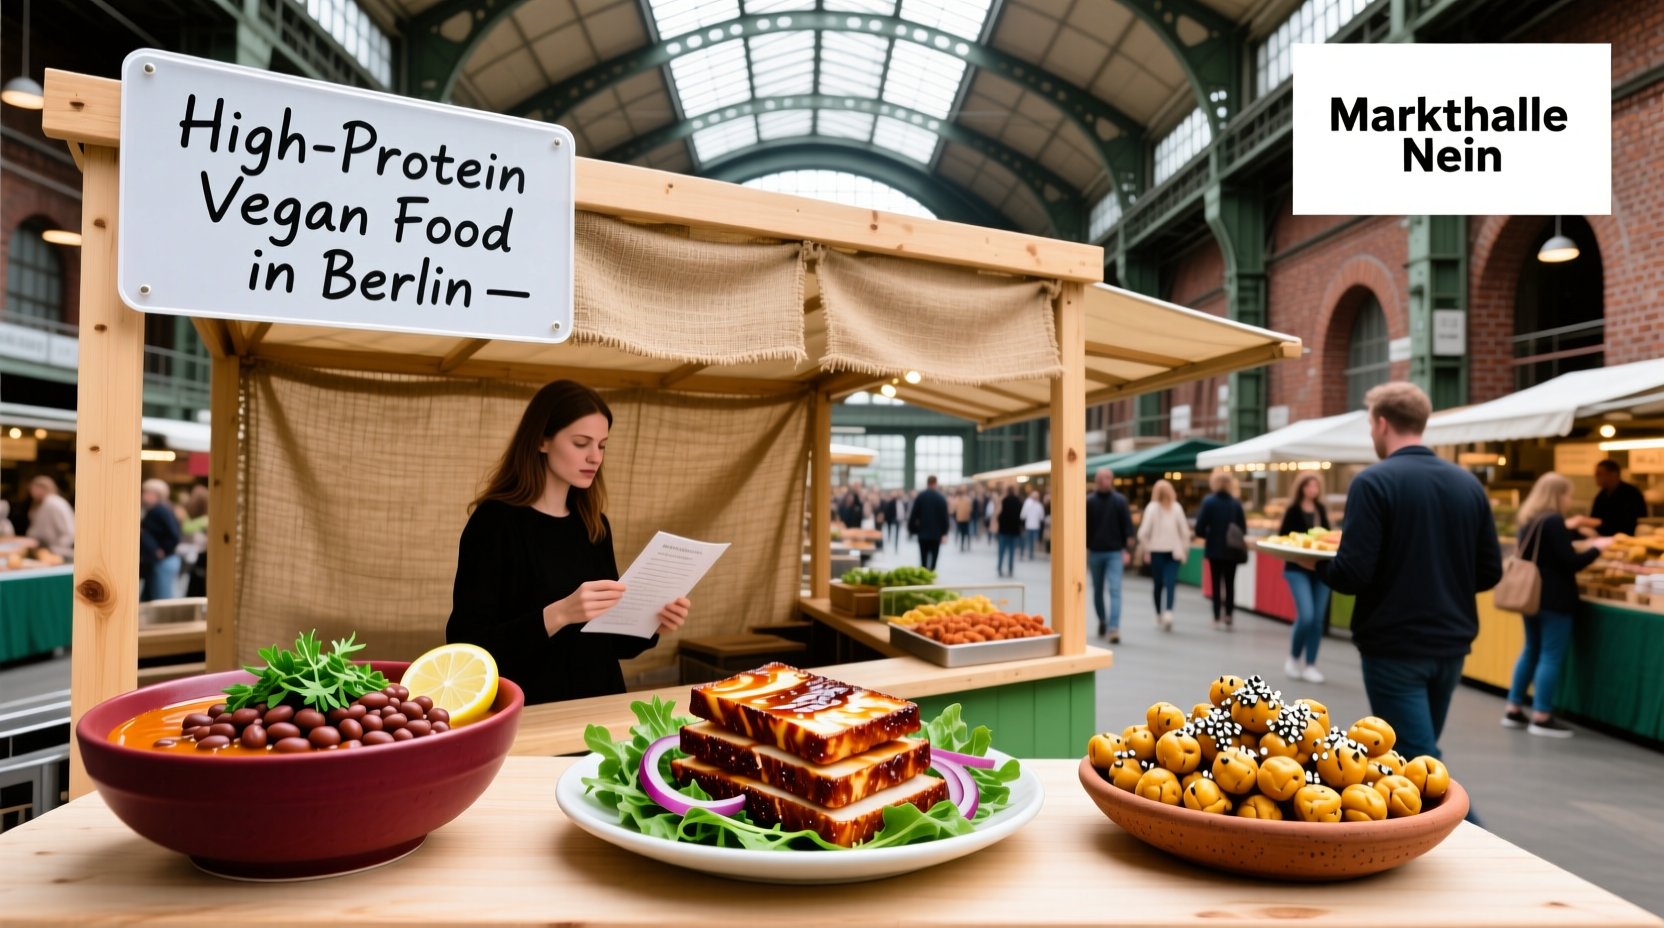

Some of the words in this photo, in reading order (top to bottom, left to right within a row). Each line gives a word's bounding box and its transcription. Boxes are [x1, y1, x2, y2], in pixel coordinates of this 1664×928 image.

[179, 93, 525, 195] High-Protein
[200, 170, 369, 248] Vegan
[394, 196, 514, 253] Food
[248, 248, 295, 294] in
[321, 248, 472, 308] Berlin
